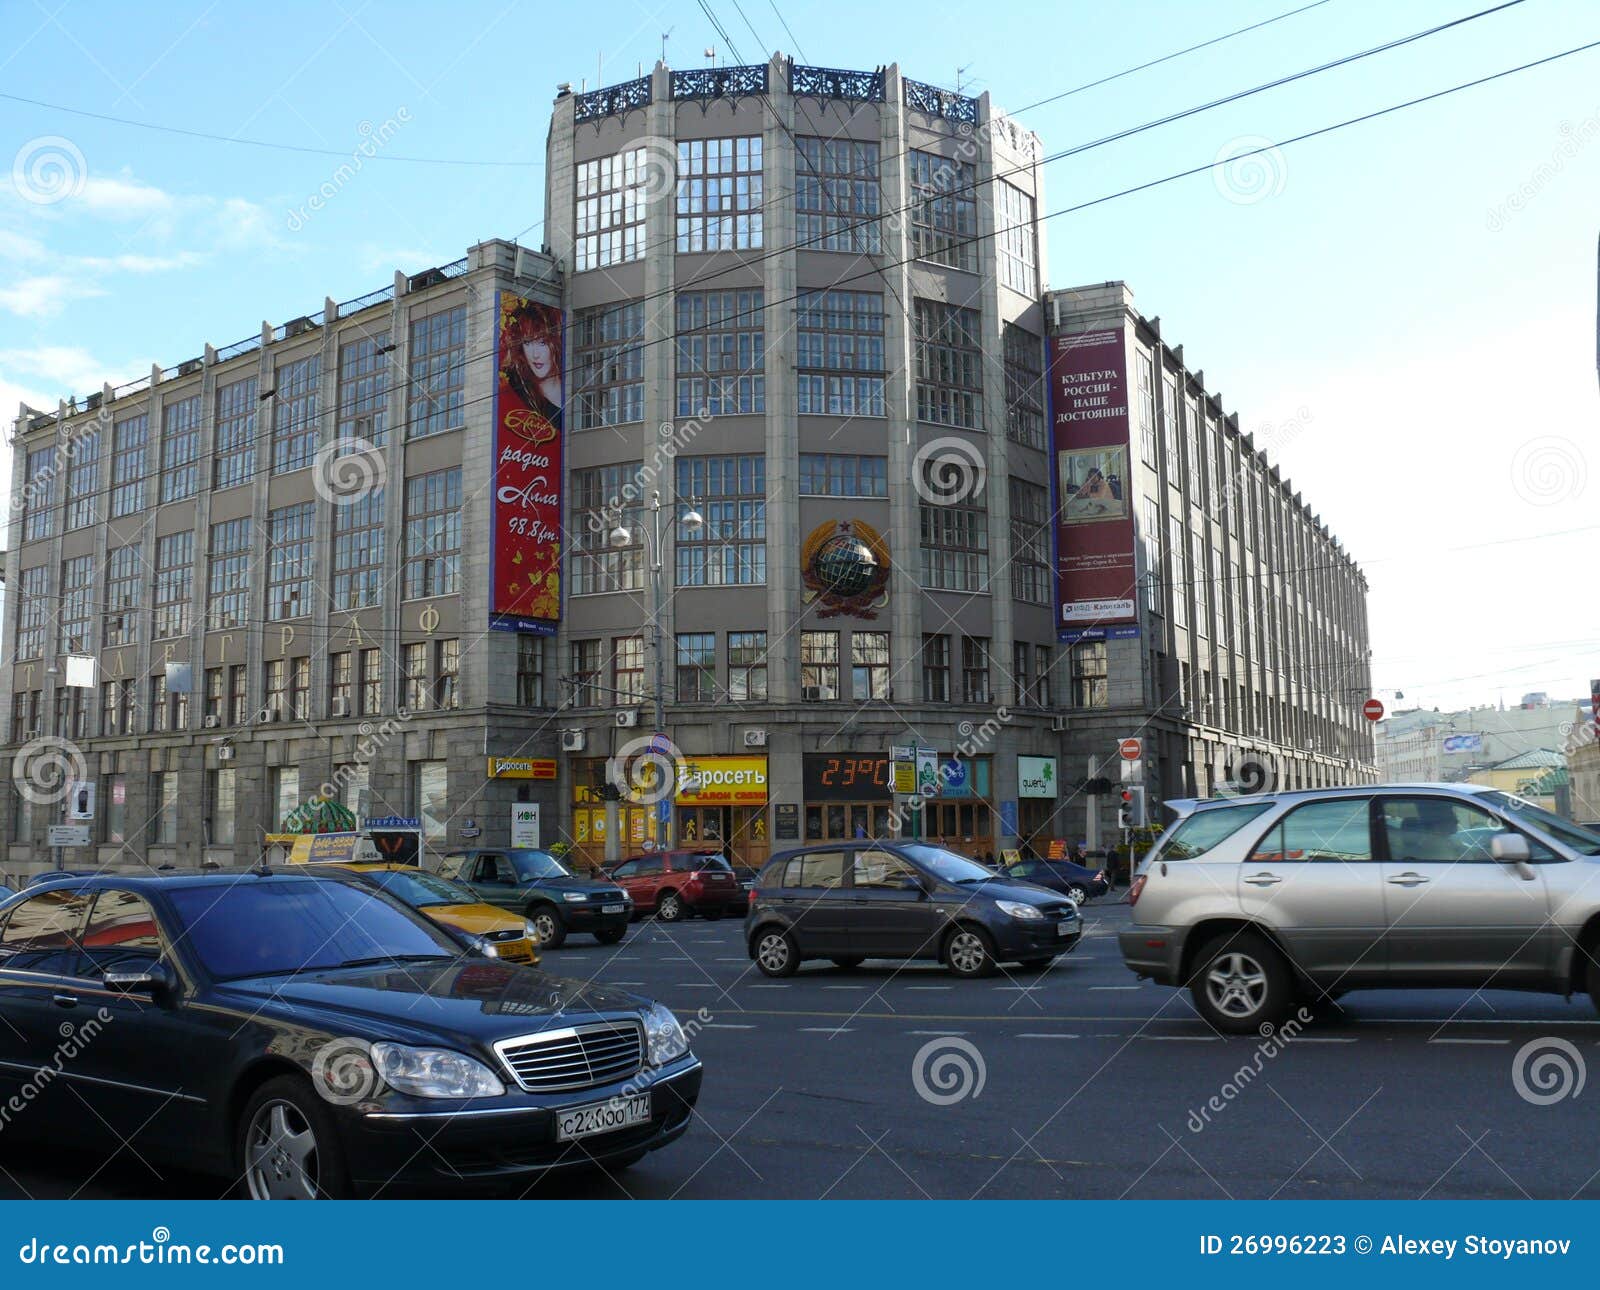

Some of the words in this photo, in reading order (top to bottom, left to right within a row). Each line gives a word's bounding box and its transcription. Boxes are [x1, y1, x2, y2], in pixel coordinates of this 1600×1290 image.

[1061, 369, 1118, 385] КУЛЬТУРА
[1063, 383, 1111, 397] РОССИИ
[1073, 396, 1109, 409] НАШЕ
[1056, 406, 1127, 424] ДОСТОЯНИЕ
[497, 476, 558, 513] Алла
[1022, 776, 1047, 794] qwerty
